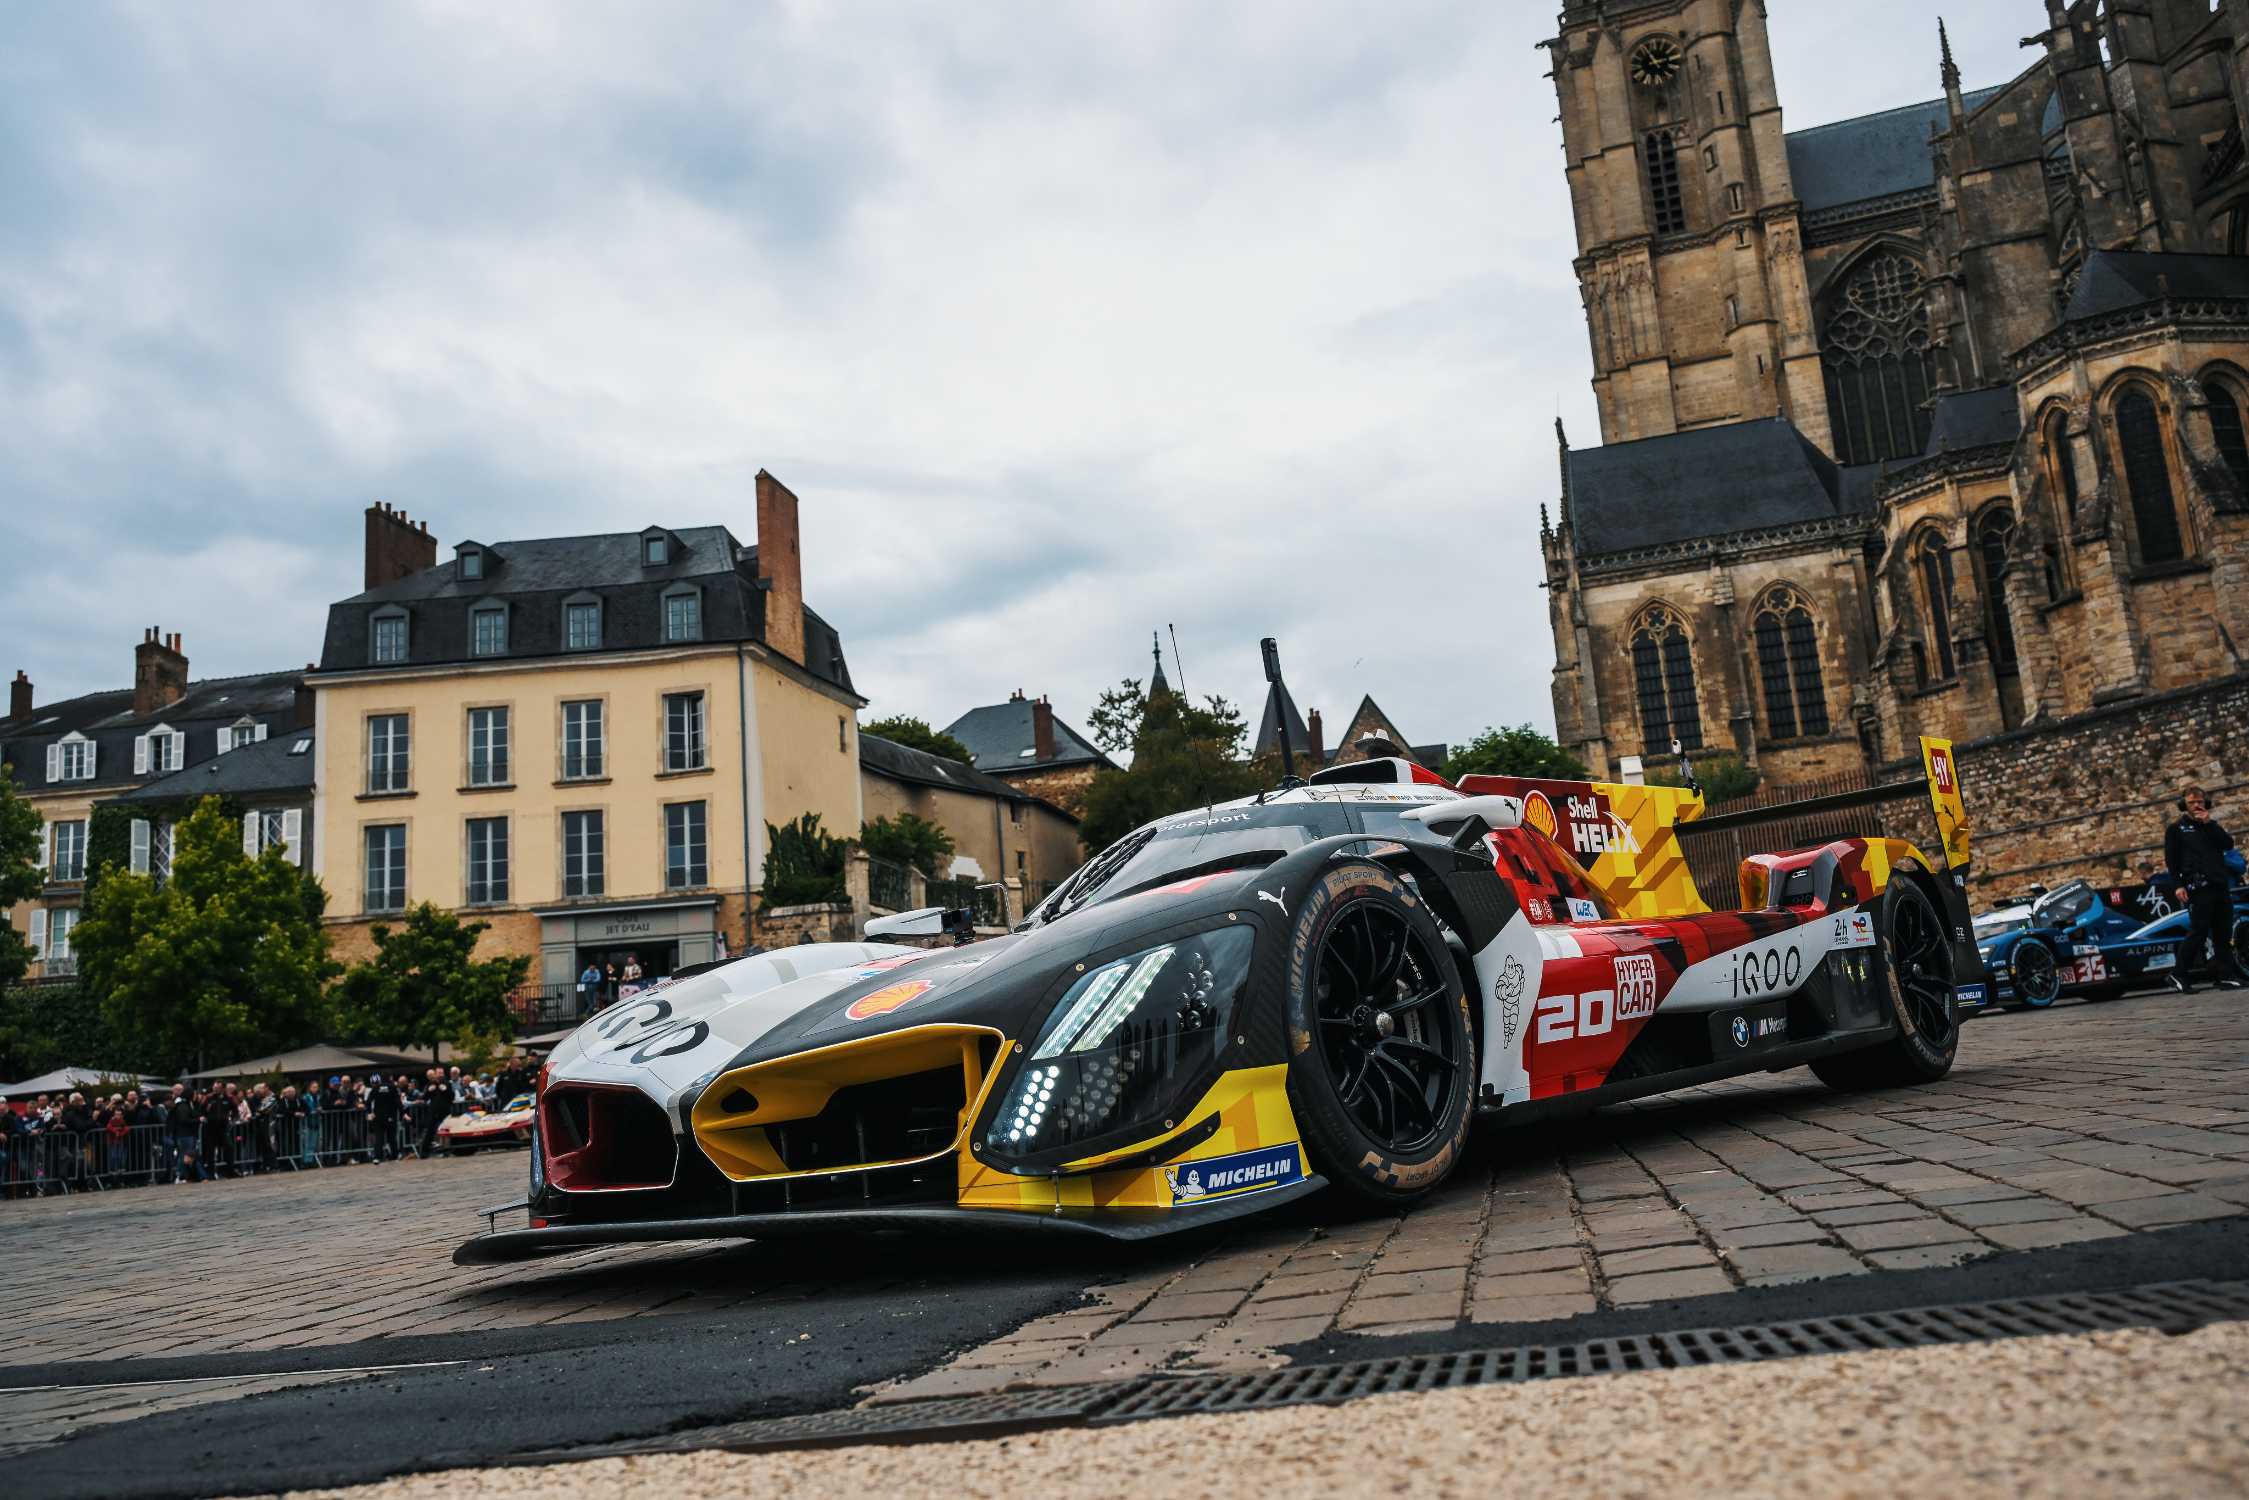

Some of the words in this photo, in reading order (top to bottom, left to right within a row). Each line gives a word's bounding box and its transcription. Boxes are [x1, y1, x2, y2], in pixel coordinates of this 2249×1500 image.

[1158, 812, 1252, 833] otorsport
[1567, 795, 1599, 819] Shell
[1569, 822, 1643, 855] HELIX
[1616, 959, 1654, 981] HYPER
[1618, 980, 1654, 1016] CAR
[1537, 989, 1615, 1045] 20
[1207, 1158, 1292, 1190] MICHELIN
